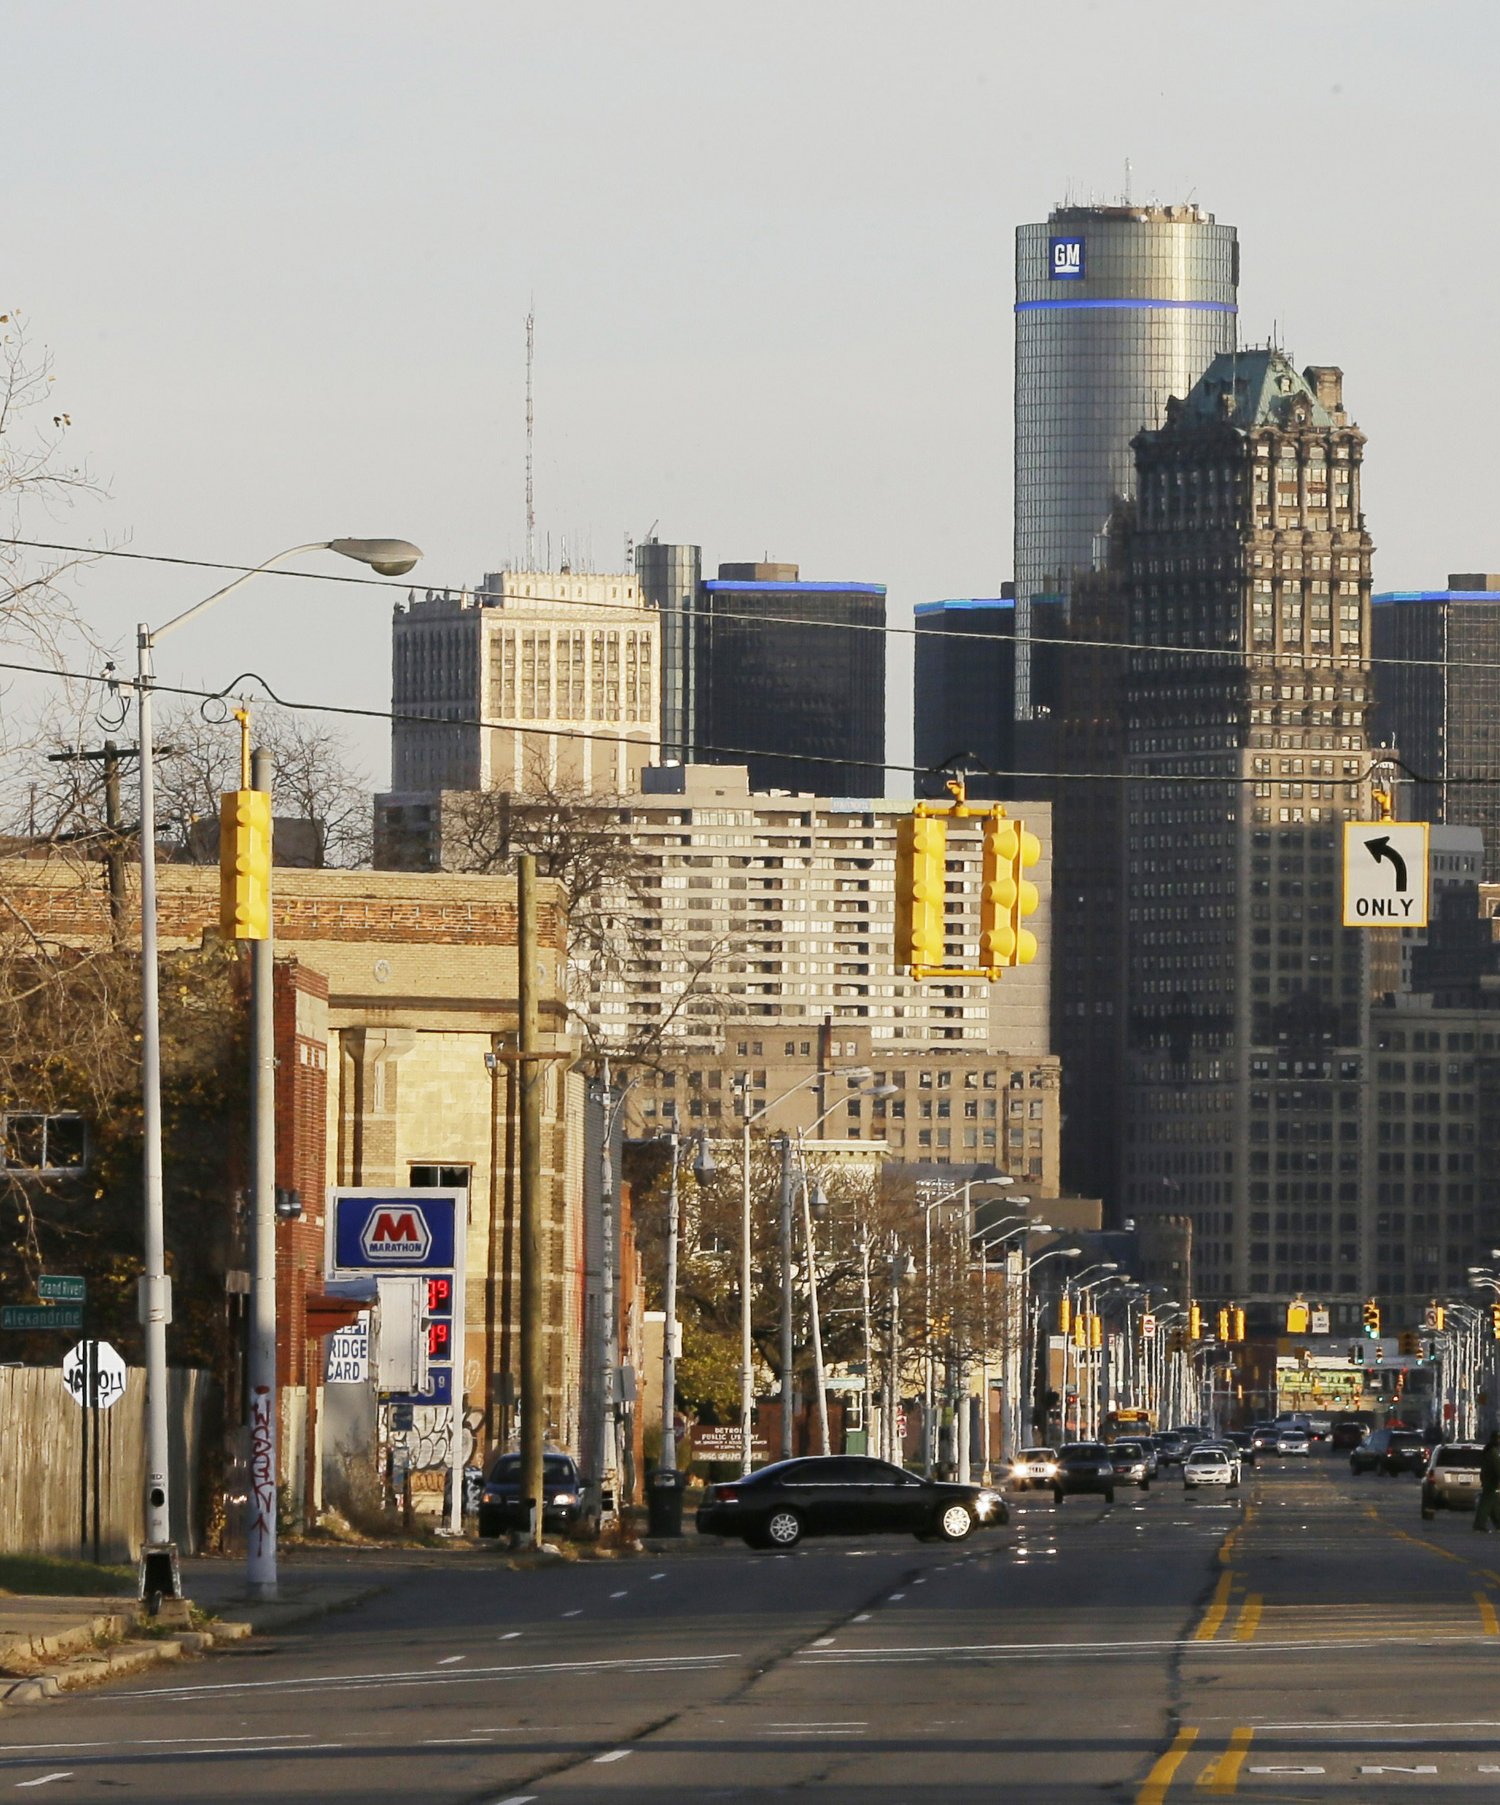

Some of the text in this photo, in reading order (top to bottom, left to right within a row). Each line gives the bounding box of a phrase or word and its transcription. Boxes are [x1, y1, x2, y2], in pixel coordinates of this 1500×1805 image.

[1054, 243, 1080, 266] GM
[1356, 898, 1414, 916] ONLY
[371, 1213, 420, 1242] M
[369, 1243, 422, 1252] MARATHON
[40, 1280, 83, 1296] Grand River
[4, 1307, 80, 1326] Alexandrine
[327, 1361, 360, 1381] CARD
